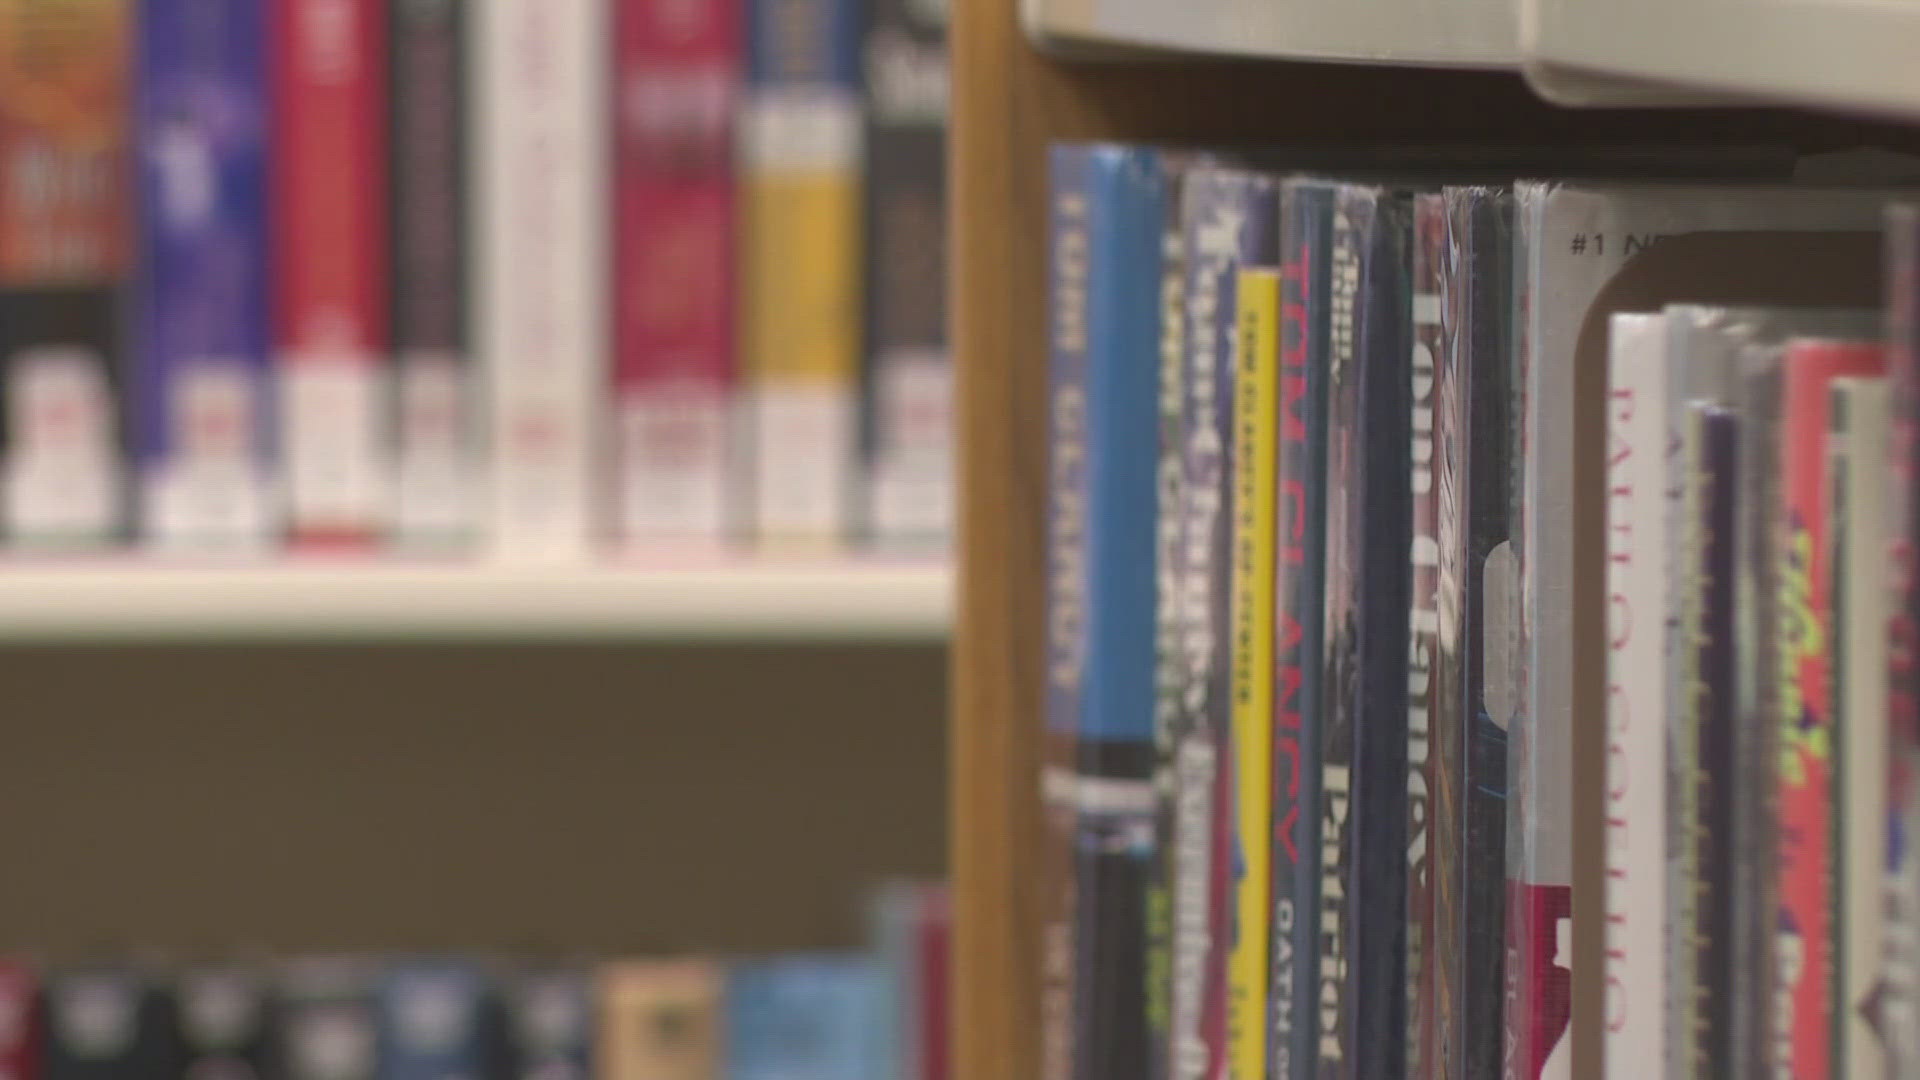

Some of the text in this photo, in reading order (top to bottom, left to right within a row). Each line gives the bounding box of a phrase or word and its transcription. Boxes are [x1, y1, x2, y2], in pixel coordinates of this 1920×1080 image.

[1570, 232, 1603, 255] #1
[1411, 272, 1442, 494] Tom
[1275, 243, 1310, 863] TOM CLANCY
[1605, 385, 1634, 652] PAULO
[1407, 534, 1438, 888] Clancy
[1275, 898, 1295, 1032] OATH
[1318, 763, 1351, 1061] Patriot
